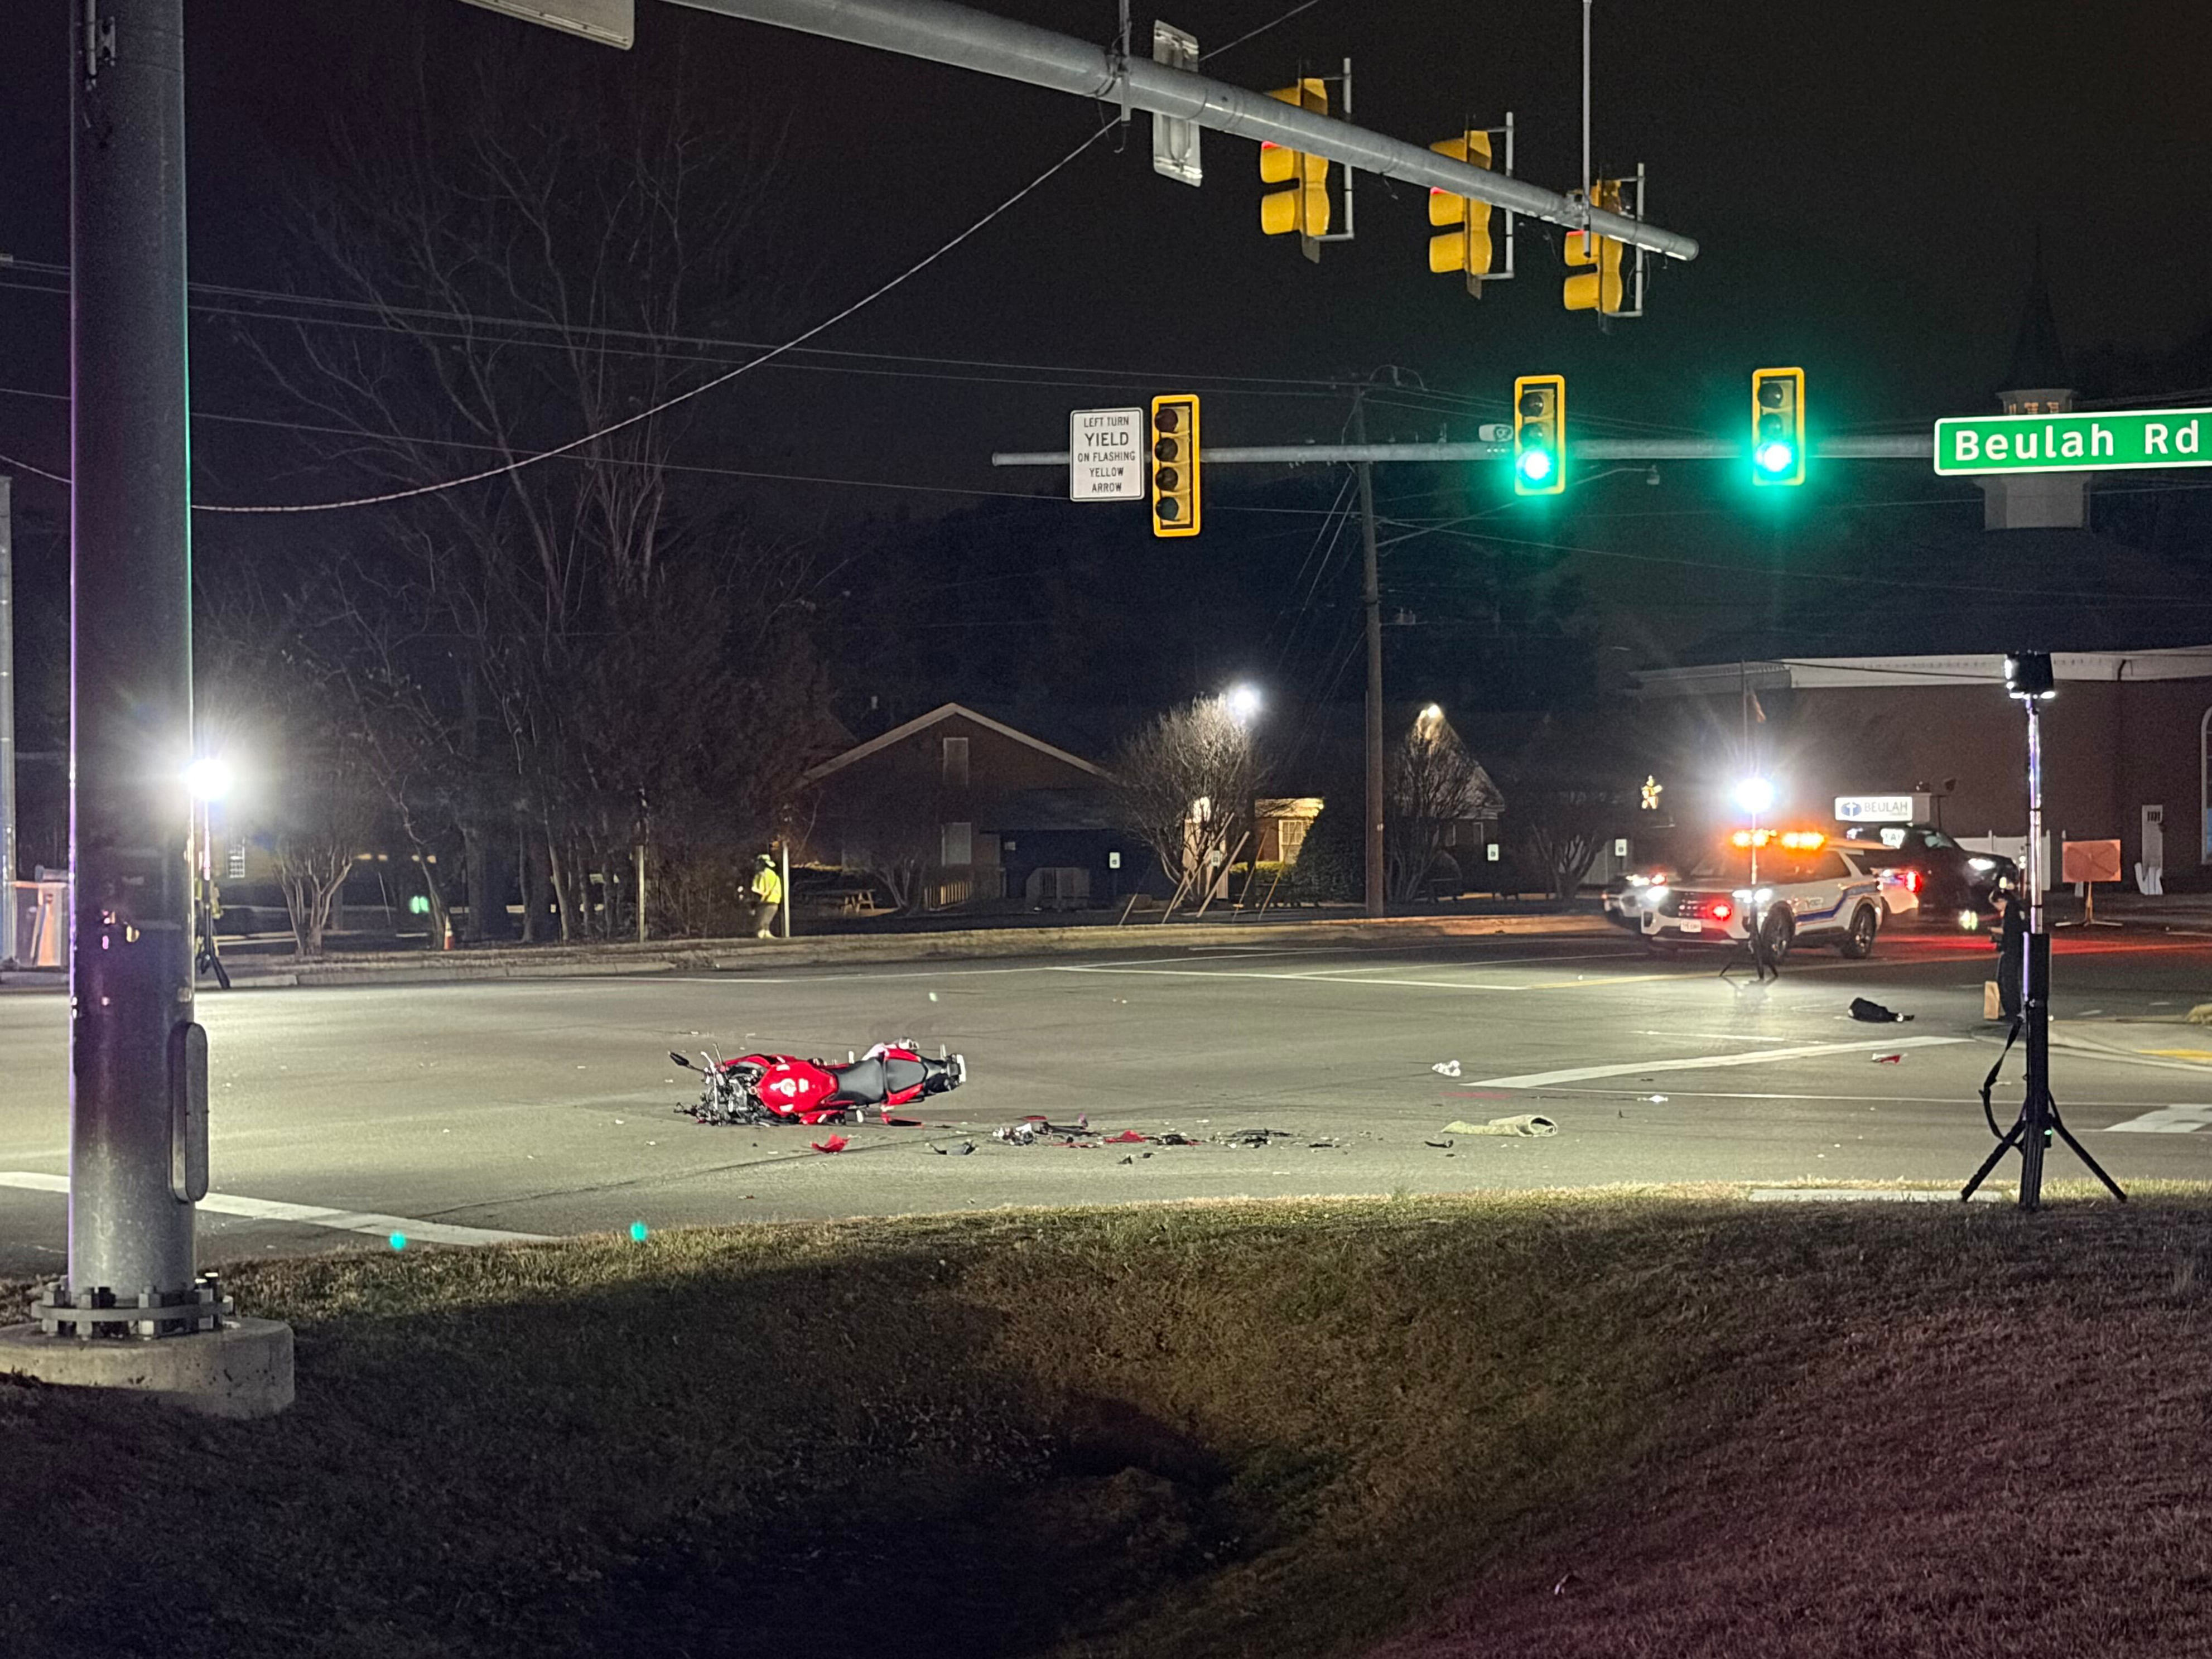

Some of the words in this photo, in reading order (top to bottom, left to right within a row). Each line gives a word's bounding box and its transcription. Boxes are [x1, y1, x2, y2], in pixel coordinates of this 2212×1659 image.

[1083, 417, 1103, 427] LEFT
[1107, 416, 1129, 426] TURN
[1085, 432, 1129, 447] YIELD
[1955, 423, 2114, 461] Beulah
[2144, 419, 2199, 454] Rd
[1078, 452, 1090, 462] ON
[1093, 451, 1135, 462] FLASHING
[1090, 467, 1124, 477] YELLOW
[1092, 483, 1122, 493] ARROW
[1864, 801, 1908, 812] BEULAH
